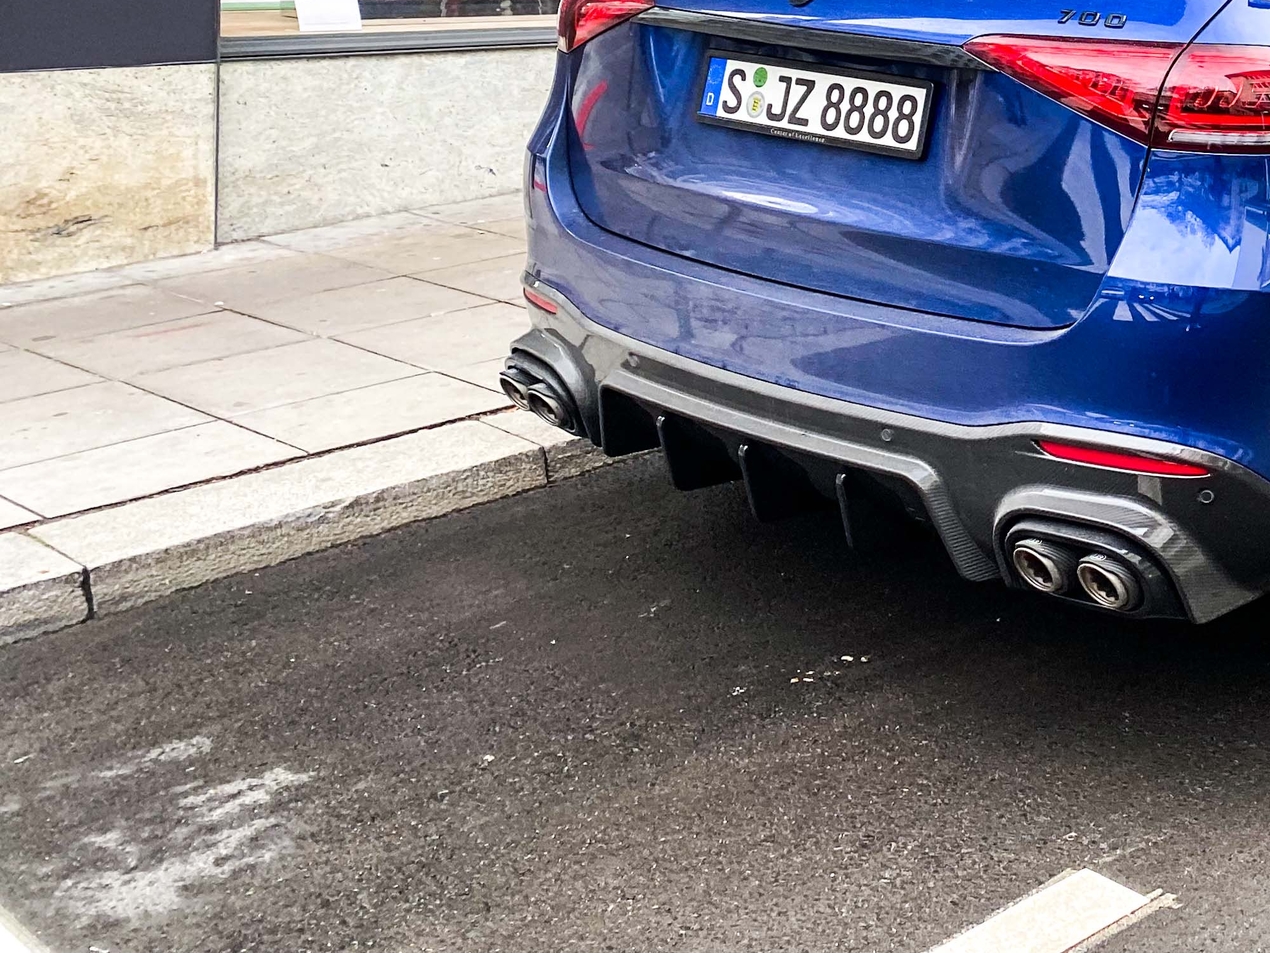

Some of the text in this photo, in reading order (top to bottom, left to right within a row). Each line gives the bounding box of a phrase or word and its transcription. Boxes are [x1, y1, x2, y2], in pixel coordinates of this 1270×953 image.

[1057, 8, 1128, 30] 700
[705, 68, 919, 144] D S JZ 8888
